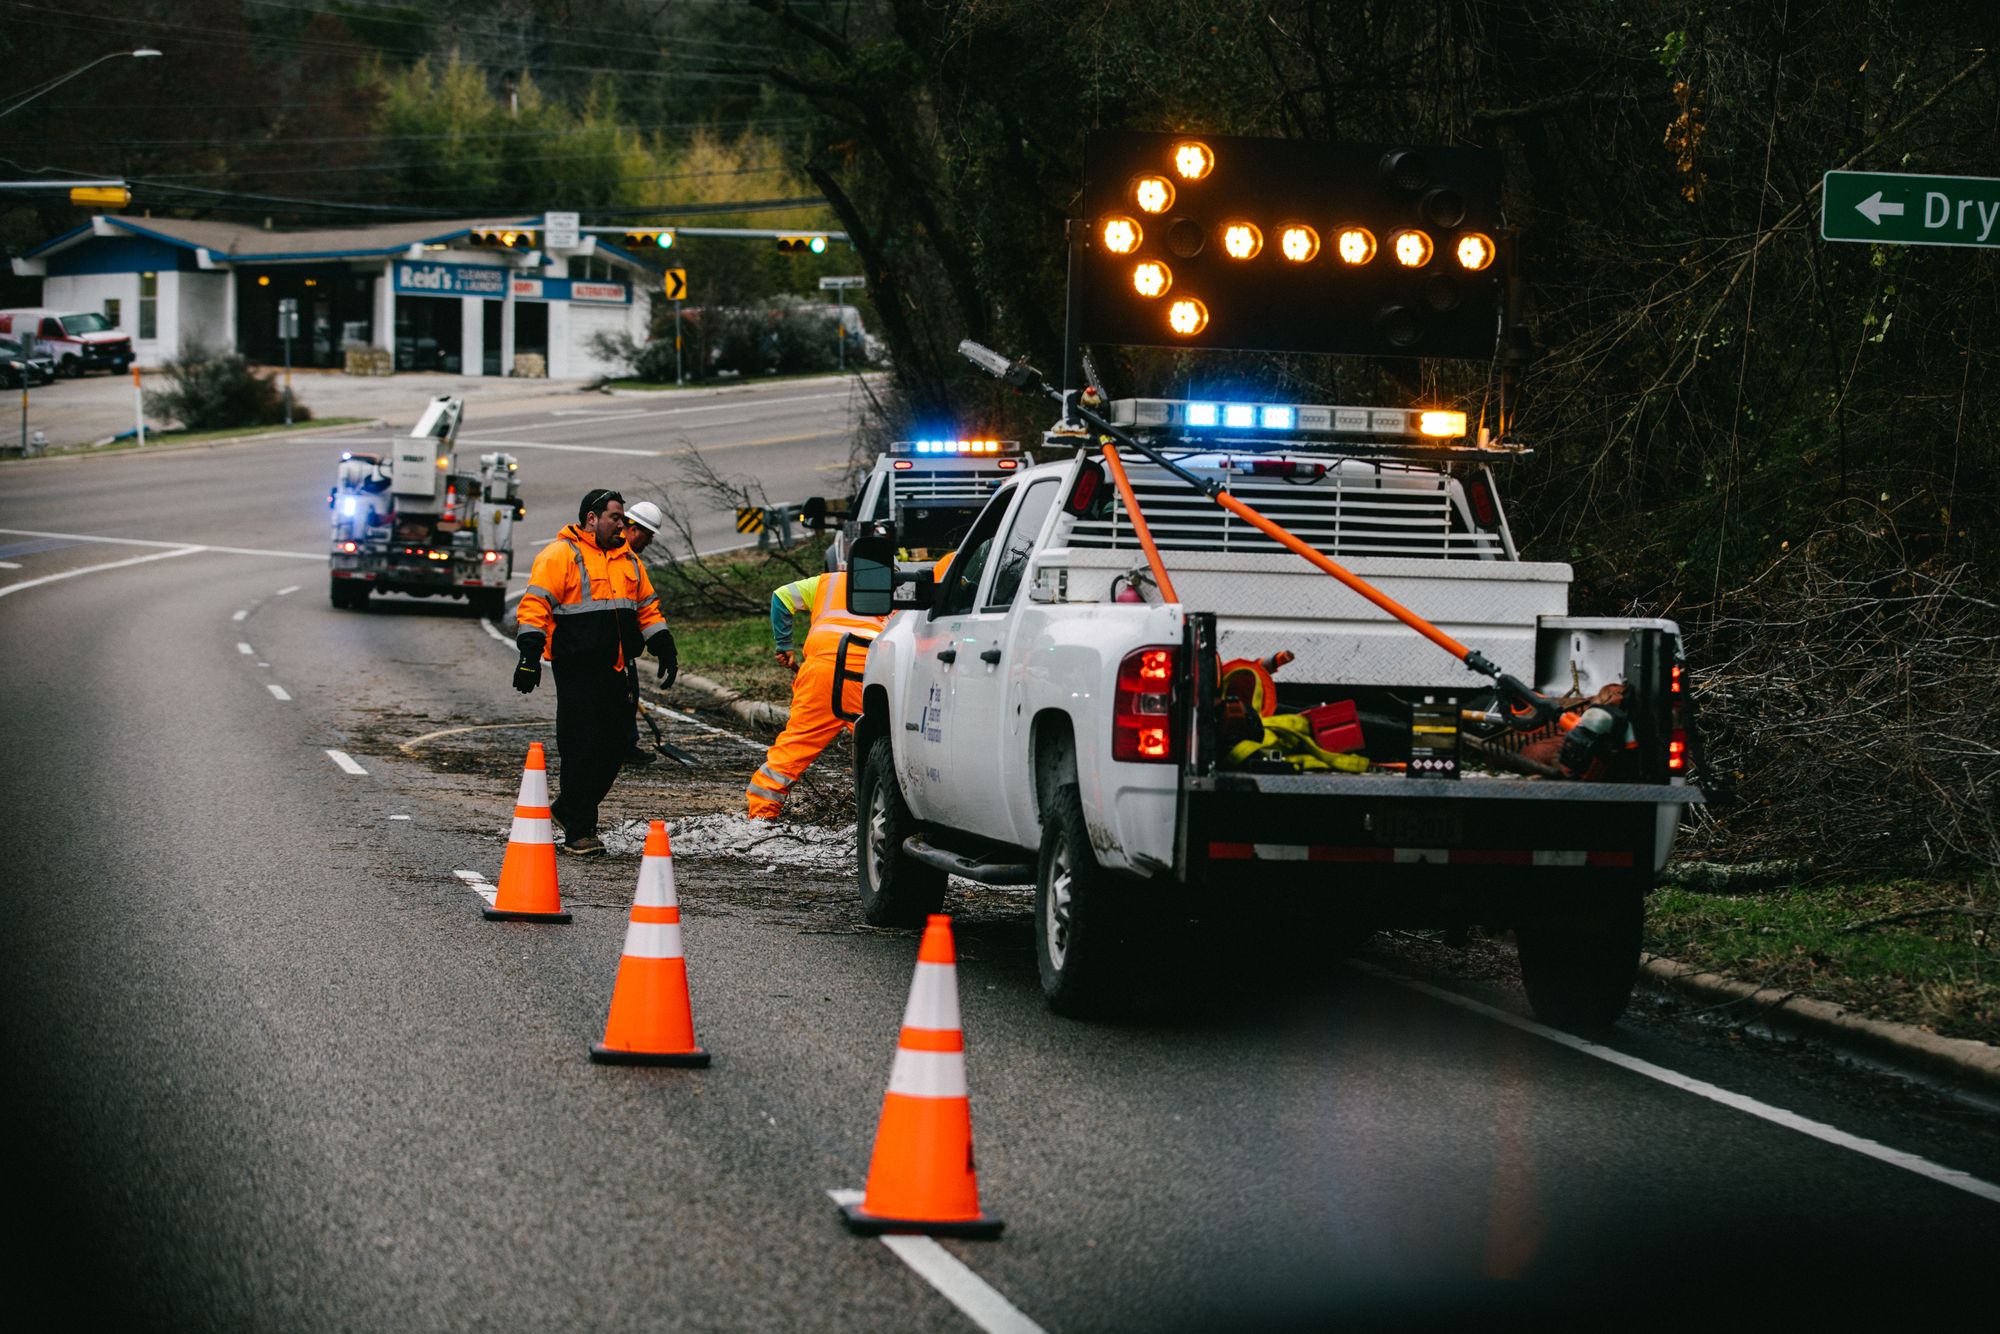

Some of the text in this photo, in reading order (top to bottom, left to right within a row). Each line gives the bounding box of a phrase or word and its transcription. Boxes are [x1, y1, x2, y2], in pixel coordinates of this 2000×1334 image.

[1924, 191, 2000, 242] Dry
[400, 265, 452, 290] Reid's
[456, 268, 503, 281] CLEANERS
